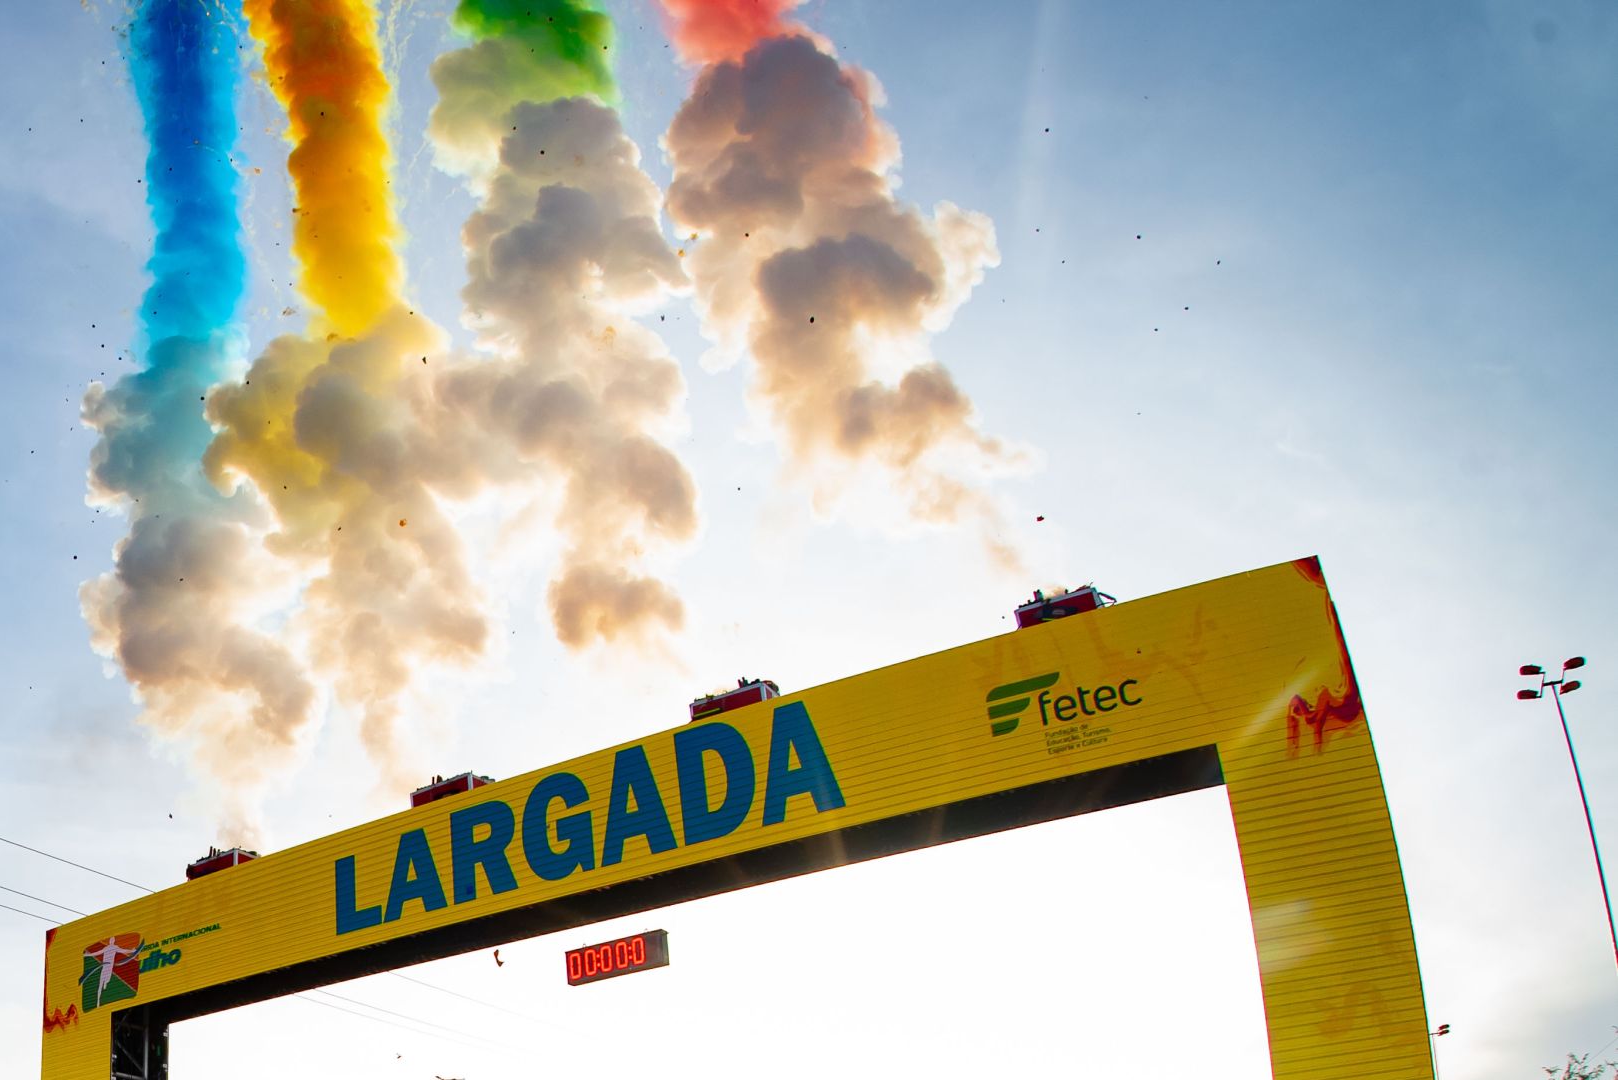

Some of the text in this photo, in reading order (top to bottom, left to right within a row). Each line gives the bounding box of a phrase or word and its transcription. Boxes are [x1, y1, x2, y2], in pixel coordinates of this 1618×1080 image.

[1038, 679, 1142, 726] fetec
[335, 700, 846, 936] LARGADA
[161, 923, 221, 946] INTERNACIONAL
[139, 949, 181, 974] ulho
